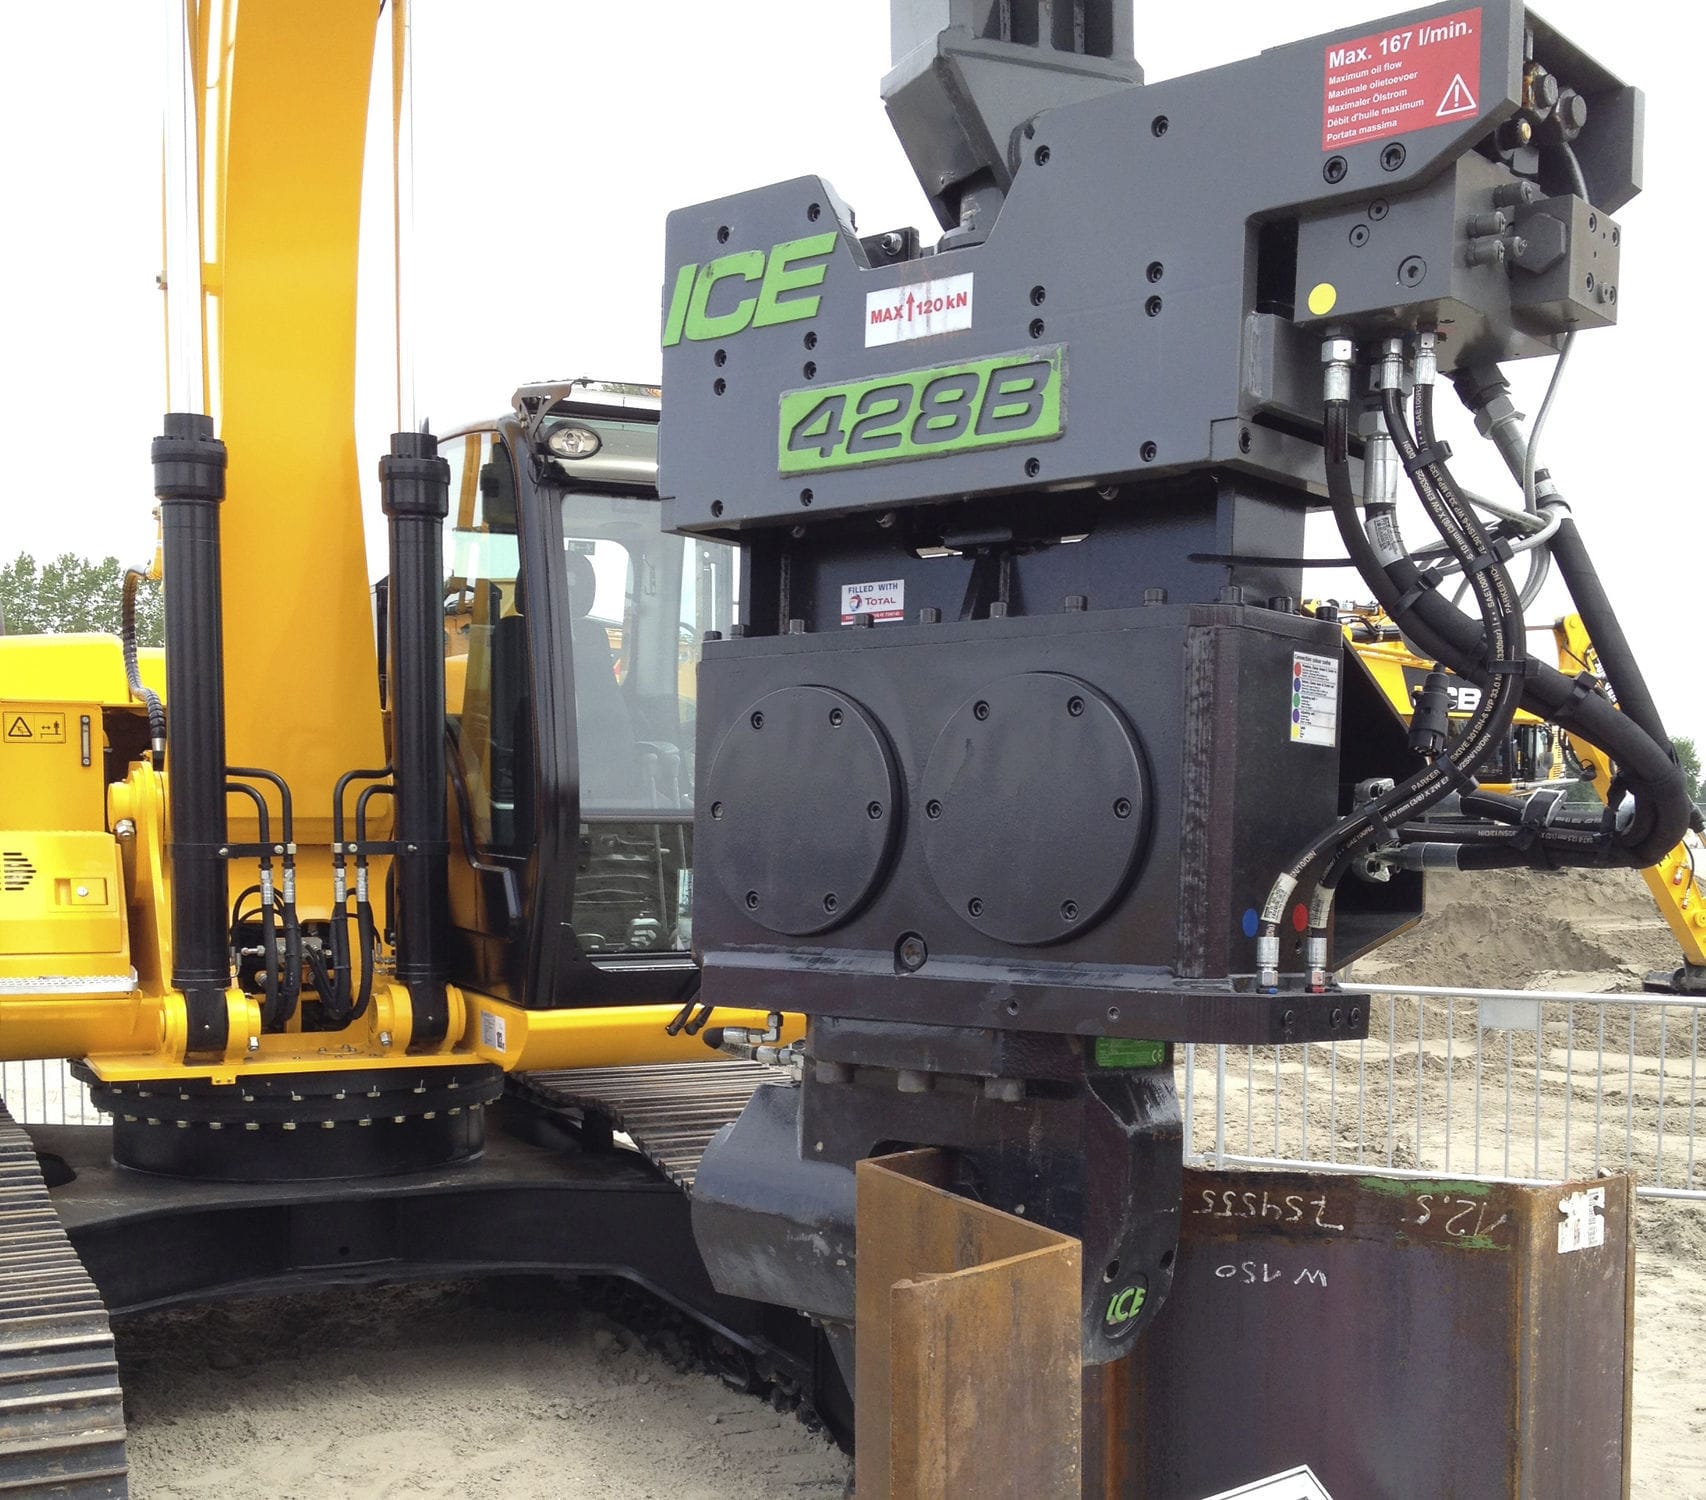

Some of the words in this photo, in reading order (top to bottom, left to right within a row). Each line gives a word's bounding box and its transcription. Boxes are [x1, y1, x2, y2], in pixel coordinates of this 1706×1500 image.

[1329, 47, 1372, 69] Max.
[1379, 32, 1413, 56] 167
[1418, 21, 1473, 47] l/min.
[1328, 69, 1369, 85] Maximum
[1371, 64, 1382, 75] oil
[1384, 60, 1403, 72] flow
[1328, 84, 1367, 100] Maximale
[1369, 71, 1418, 89] olietoevoer
[1327, 98, 1370, 114] Maximaler
[1373, 88, 1408, 103] Ölstrom
[1327, 115, 1349, 128] Débit
[1351, 107, 1379, 123] d'huile
[1381, 99, 1424, 115] maximum
[1327, 127, 1357, 142] Portata
[1359, 119, 1398, 134] massima
[662, 231, 837, 348] ICE
[871, 304, 904, 324] MAX
[917, 297, 943, 316] 120
[946, 291, 967, 310] kN
[787, 360, 1052, 458] 428B
[1454, 507, 1465, 519] WP
[848, 585, 874, 594] FILLED
[878, 582, 898, 592] WITH
[865, 597, 896, 606] TOTAL
[1476, 571, 1495, 608] SAE100R
[1497, 581, 1512, 614] PARKER
[1411, 769, 1441, 791] PARKER
[1450, 741, 1469, 761] SKIVE
[1484, 698, 1495, 713] WP
[1106, 1287, 1146, 1322] ICE
